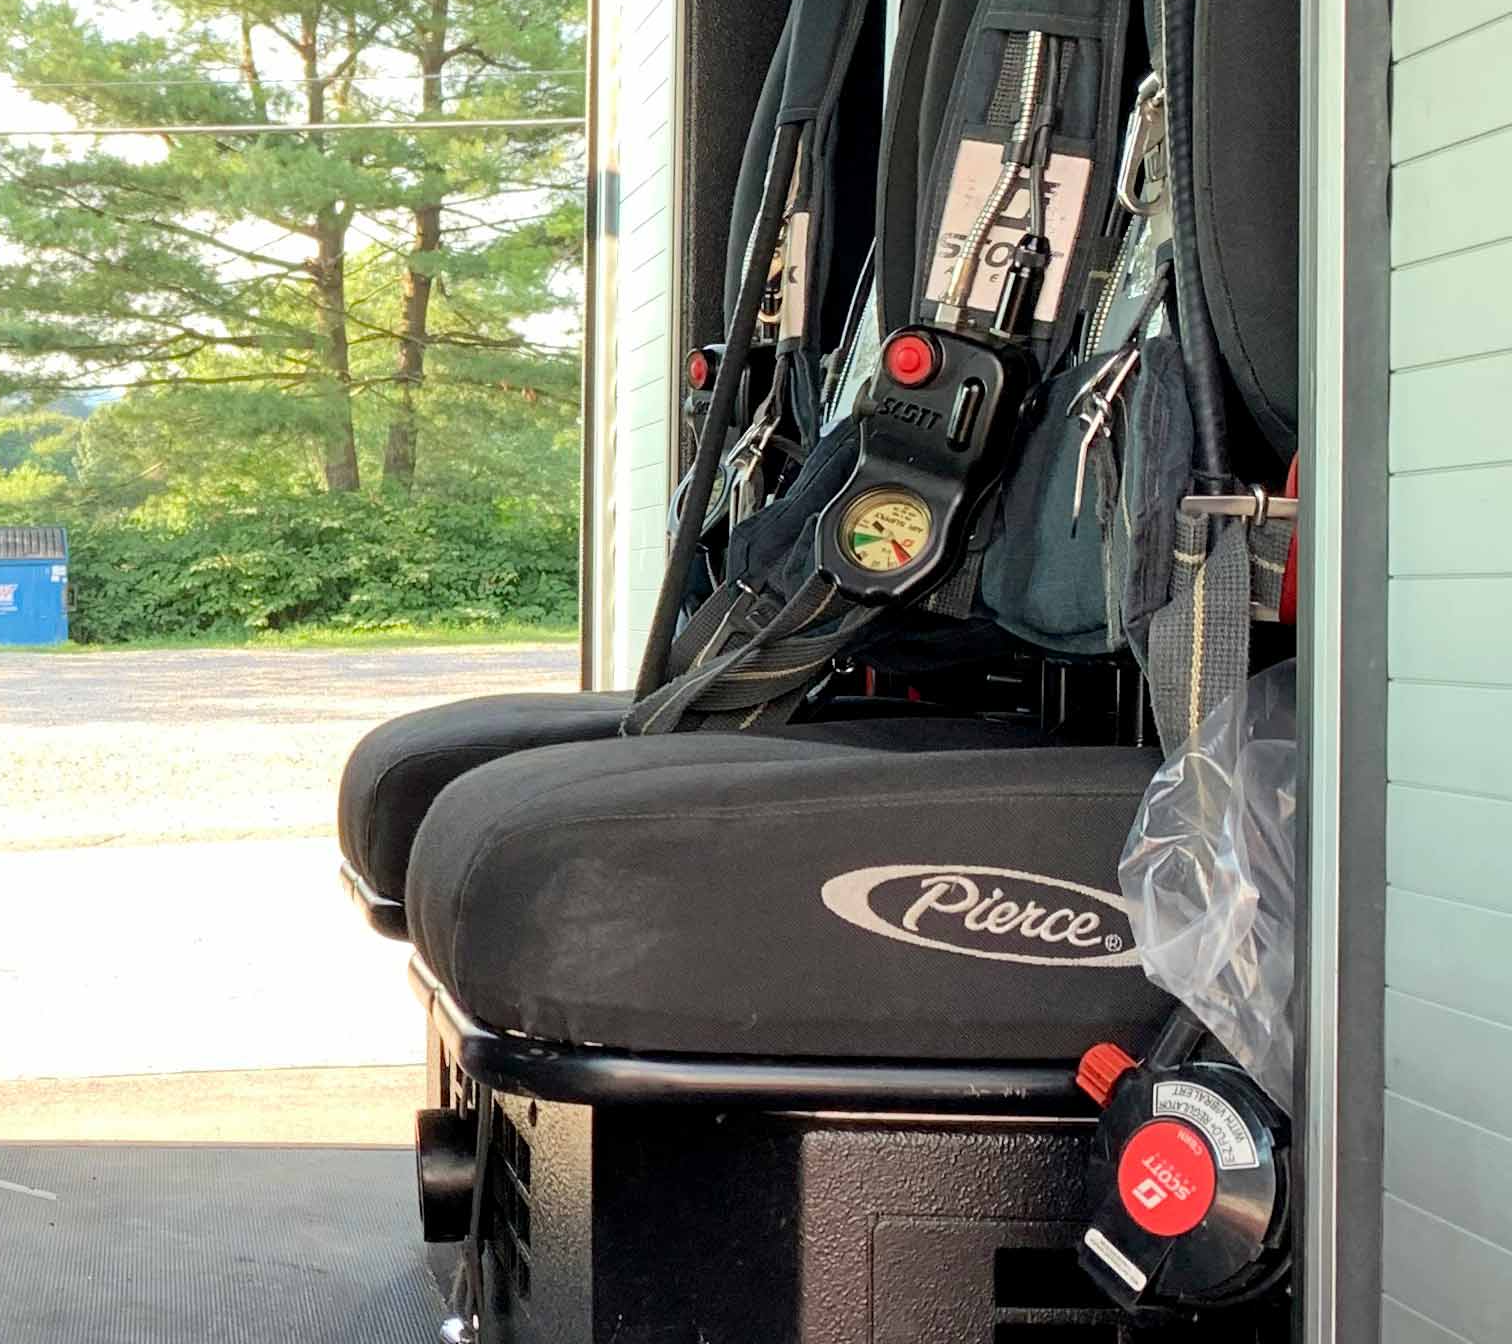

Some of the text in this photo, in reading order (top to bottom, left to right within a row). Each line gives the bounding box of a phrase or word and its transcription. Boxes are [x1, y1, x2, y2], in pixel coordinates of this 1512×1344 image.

[878, 397, 942, 430] SCOTT
[902, 874, 1103, 947] Pierce
[1159, 1100, 1212, 1126] REGULATOR
[1171, 1086, 1247, 1144] WITH VIBRALERT
[1142, 1154, 1192, 1201] SCOTT
